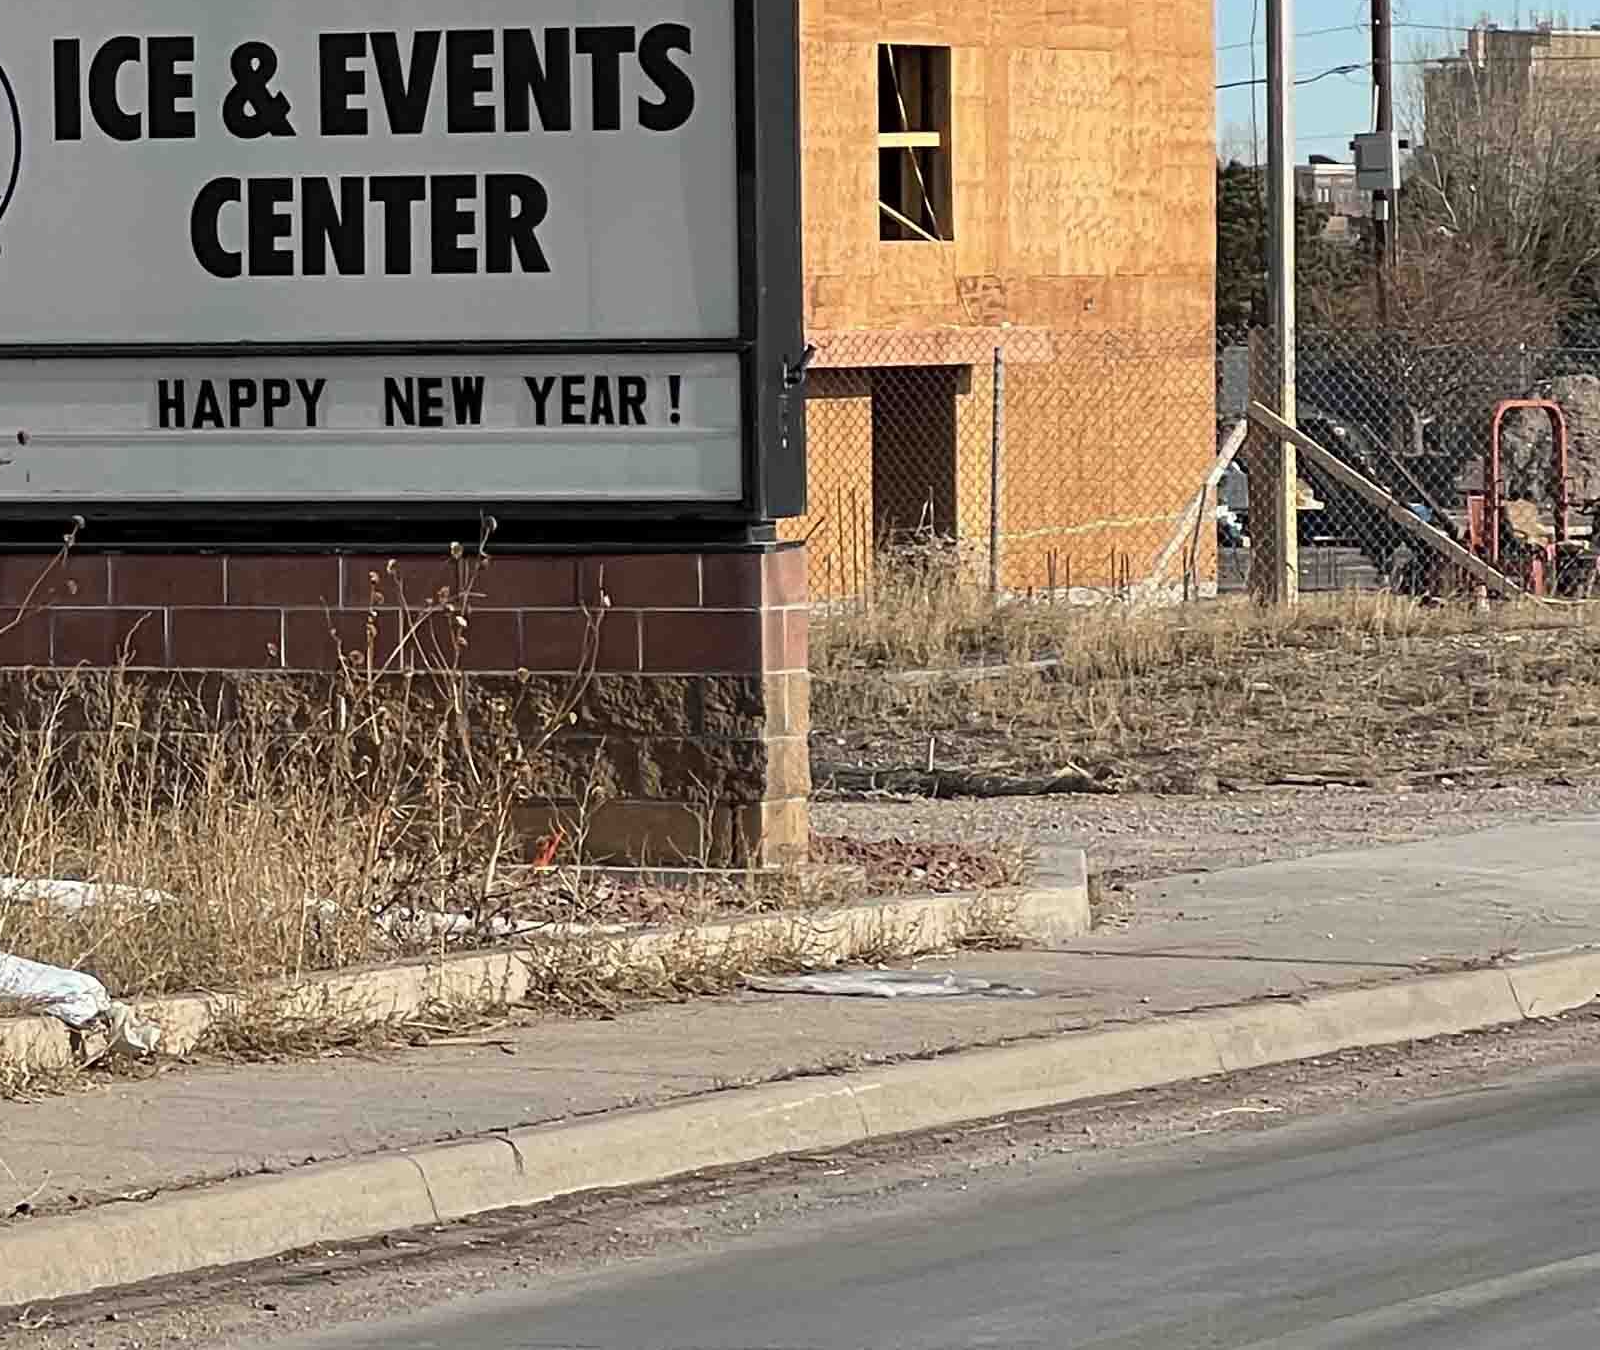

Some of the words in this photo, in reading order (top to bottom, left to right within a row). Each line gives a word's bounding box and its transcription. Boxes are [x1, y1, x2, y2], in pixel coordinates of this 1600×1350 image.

[54, 36, 195, 141] ICE
[223, 42, 296, 138] &
[319, 23, 694, 135] EVENTS
[191, 174, 550, 278] CENTER
[157, 377, 328, 429] HAPPY
[384, 375, 485, 427] NEW
